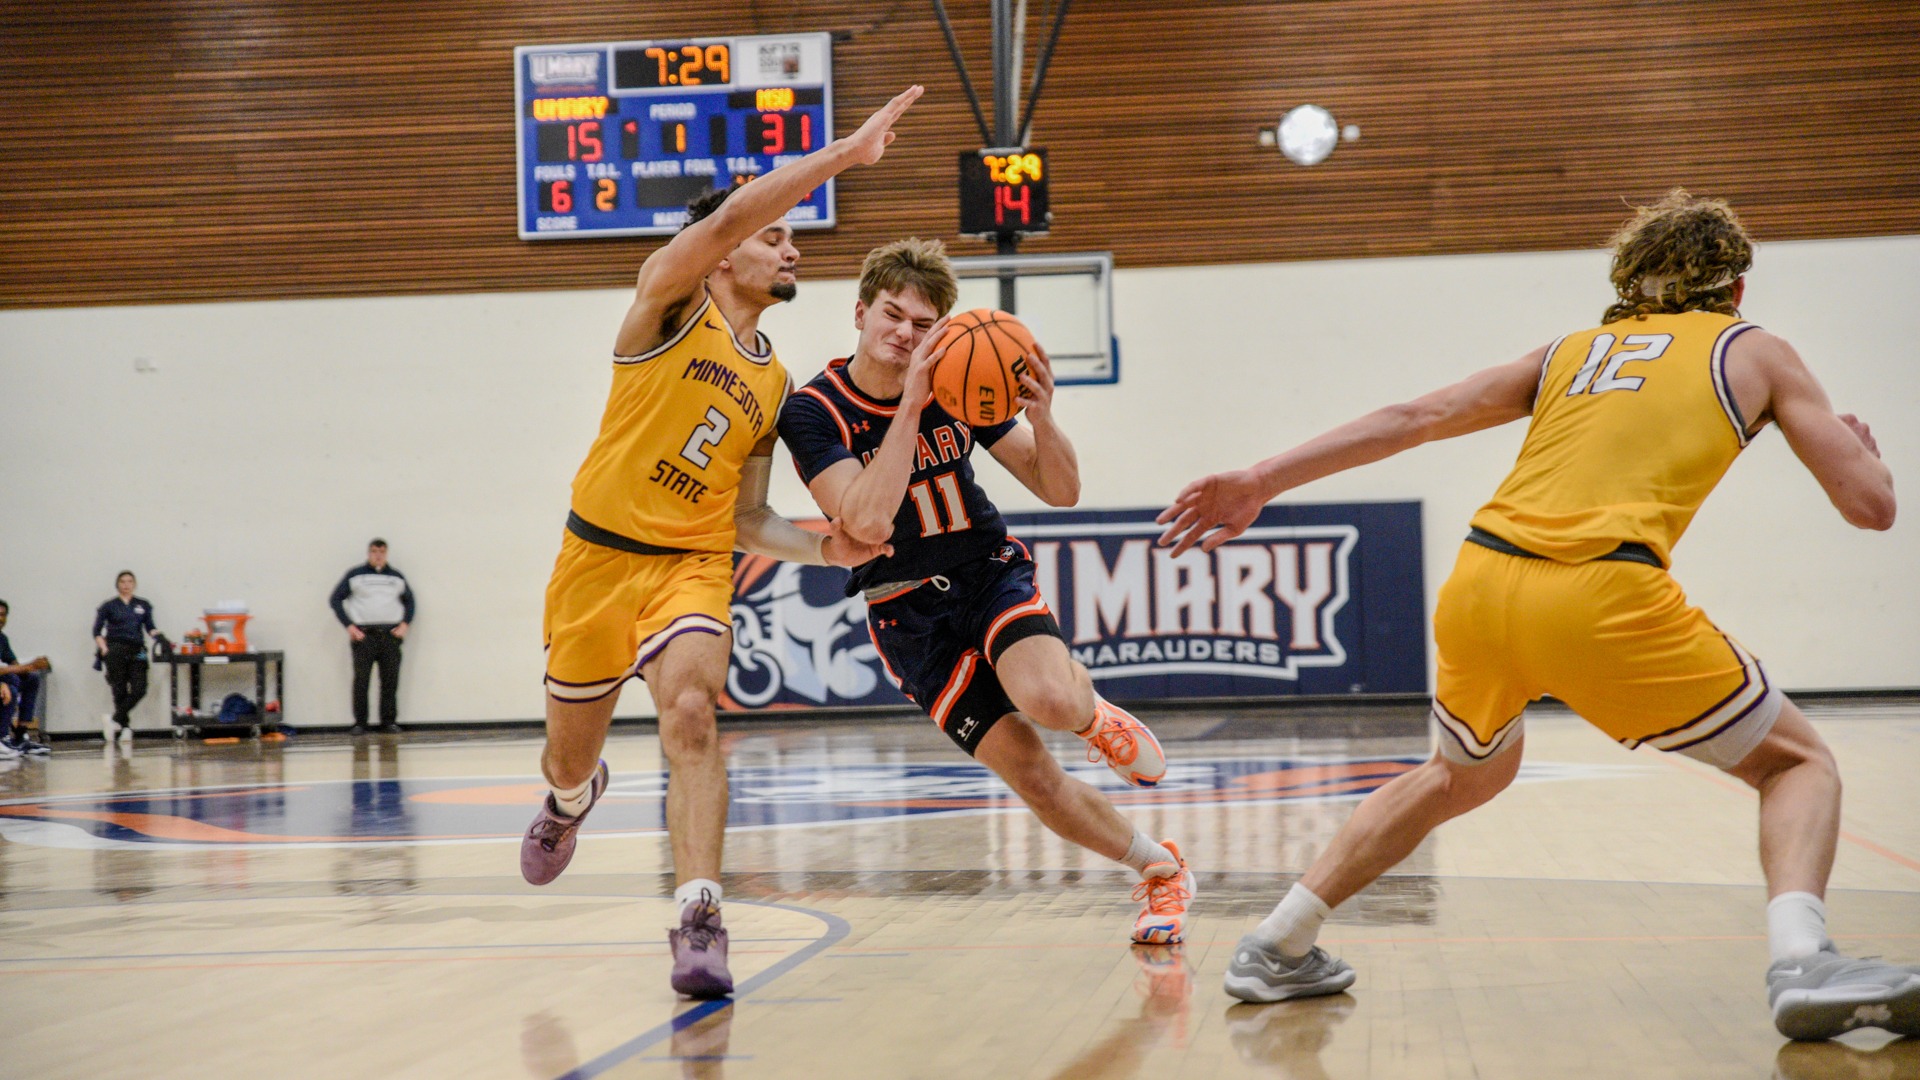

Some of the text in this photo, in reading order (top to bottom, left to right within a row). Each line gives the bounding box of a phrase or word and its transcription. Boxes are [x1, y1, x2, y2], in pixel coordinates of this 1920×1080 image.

[645, 44, 730, 86] 7:29
[650, 103, 696, 121] PERIOD
[567, 121, 604, 162] 15
[675, 123, 687, 153] 1
[761, 113, 811, 155] 31
[534, 164, 577, 182] FOULS
[631, 158, 718, 179] PLAYER FOUL
[983, 153, 1043, 185] 7:29
[551, 179, 573, 213] 6
[595, 178, 617, 211] 2
[994, 185, 1031, 226] 14
[536, 215, 578, 232] SCORE
[1565, 333, 1675, 397] 12
[681, 357, 764, 438] MINNESOTA
[679, 405, 731, 470] 2
[862, 421, 971, 474] ARY
[649, 459, 708, 503] STATE
[908, 471, 971, 538] 11
[1071, 639, 1280, 667] MARAUDERS
